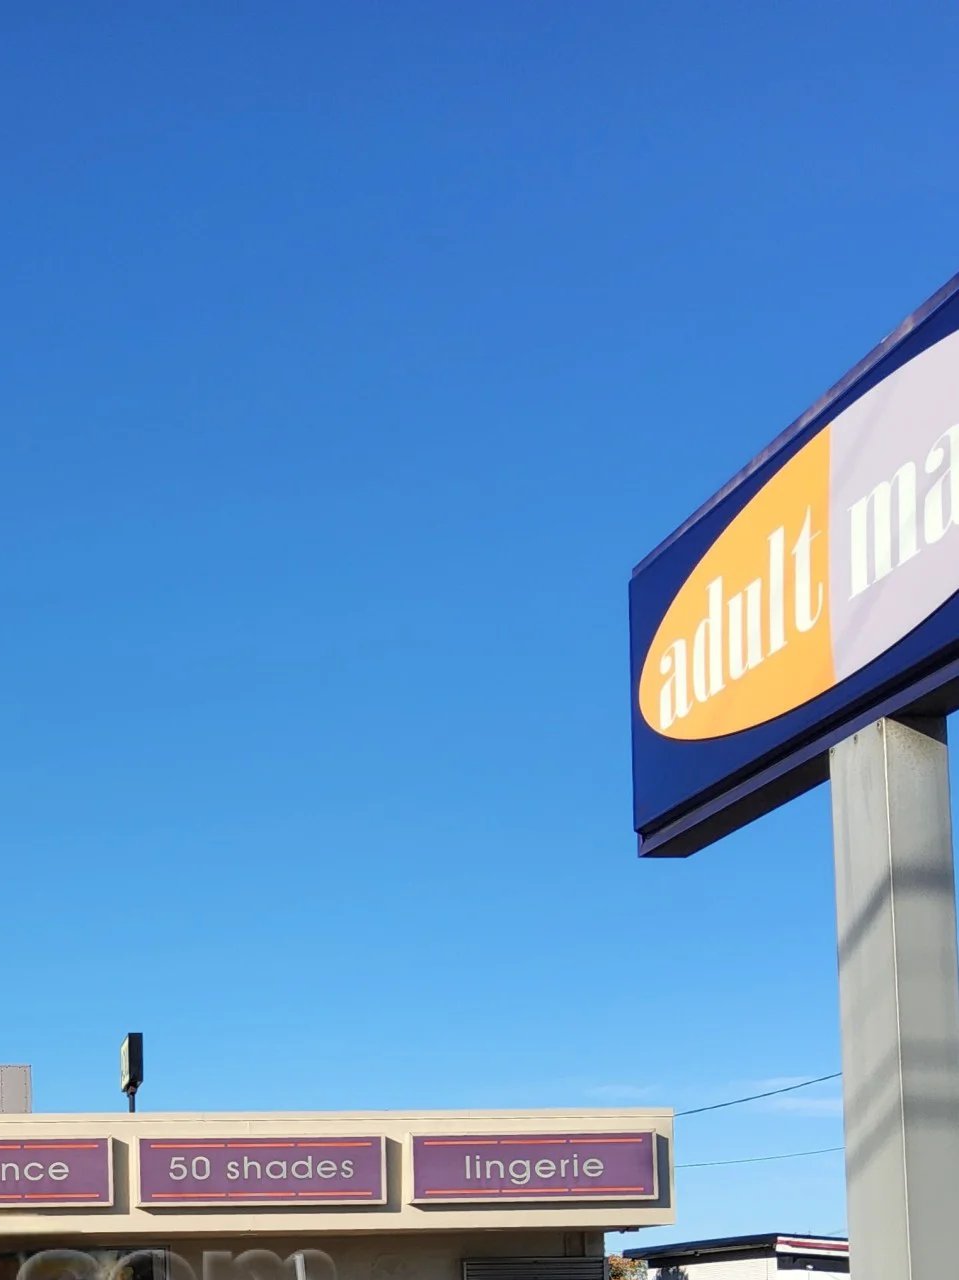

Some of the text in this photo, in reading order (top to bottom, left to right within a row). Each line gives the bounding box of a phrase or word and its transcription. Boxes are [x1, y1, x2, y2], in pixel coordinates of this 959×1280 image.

[659, 506, 824, 732] adult
[167, 1154, 355, 1181] 50 shades
[465, 1153, 605, 1186] lingerie
